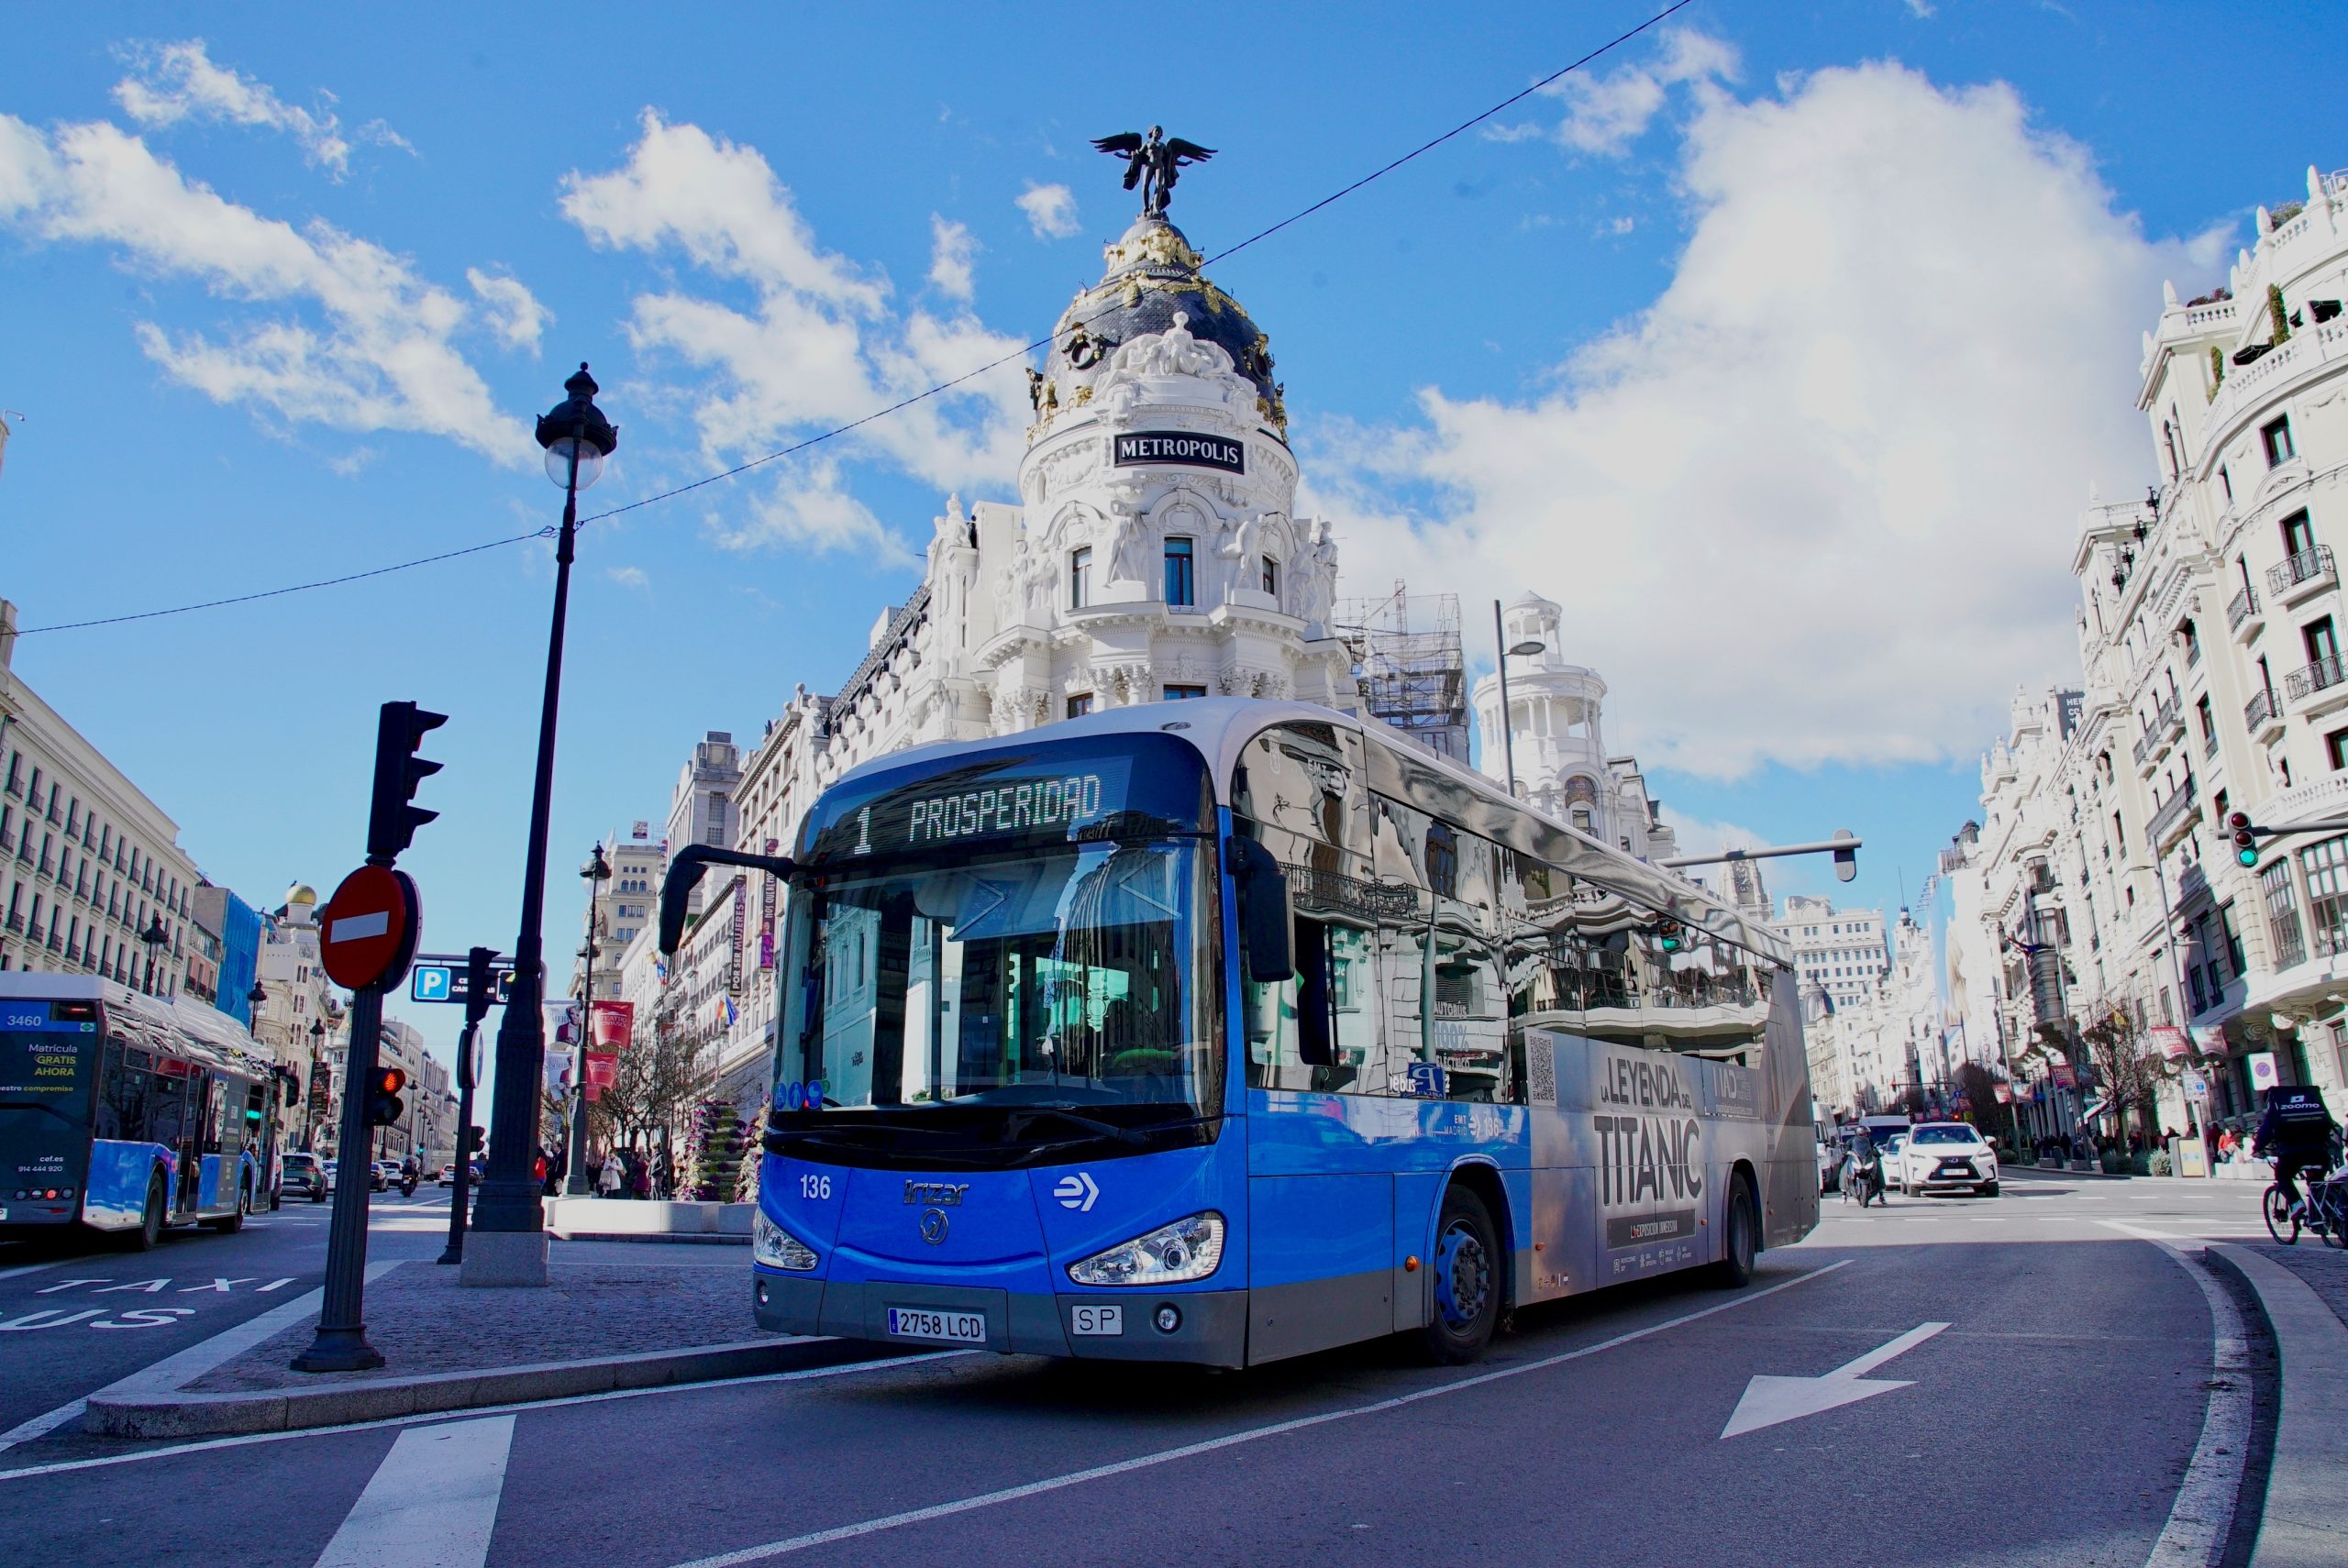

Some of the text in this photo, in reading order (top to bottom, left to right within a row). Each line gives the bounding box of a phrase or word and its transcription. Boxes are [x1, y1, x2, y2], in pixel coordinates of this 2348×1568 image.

[1121, 438, 1239, 464] METROPOLIS
[1308, 759, 1326, 777] EMT
[854, 774, 1101, 855] 1 PROSPERIDAD
[764, 905, 773, 918] NOS
[734, 903, 744, 951] MUJERES
[423, 972, 442, 995] P
[1434, 1000, 1468, 1019] AUTOBÚS
[6, 1015, 42, 1027] 3460
[1434, 1021, 1469, 1052] 100%
[37, 1055, 76, 1065] GRATIS
[35, 1067, 74, 1076] AHORA
[1600, 1057, 1692, 1110] LA LEYENDA DEL
[1454, 1114, 1467, 1124] EMT
[1484, 1118, 1500, 1137] 136
[1444, 1125, 1468, 1136] MADRID
[1594, 1115, 1702, 1207] TITANIC
[800, 1174, 831, 1199] 136
[35, 1277, 298, 1294] TAXI
[0, 1308, 196, 1331] US
[900, 1312, 942, 1335] 2758
[947, 1316, 980, 1338] LCD
[1079, 1309, 1115, 1331] SP
